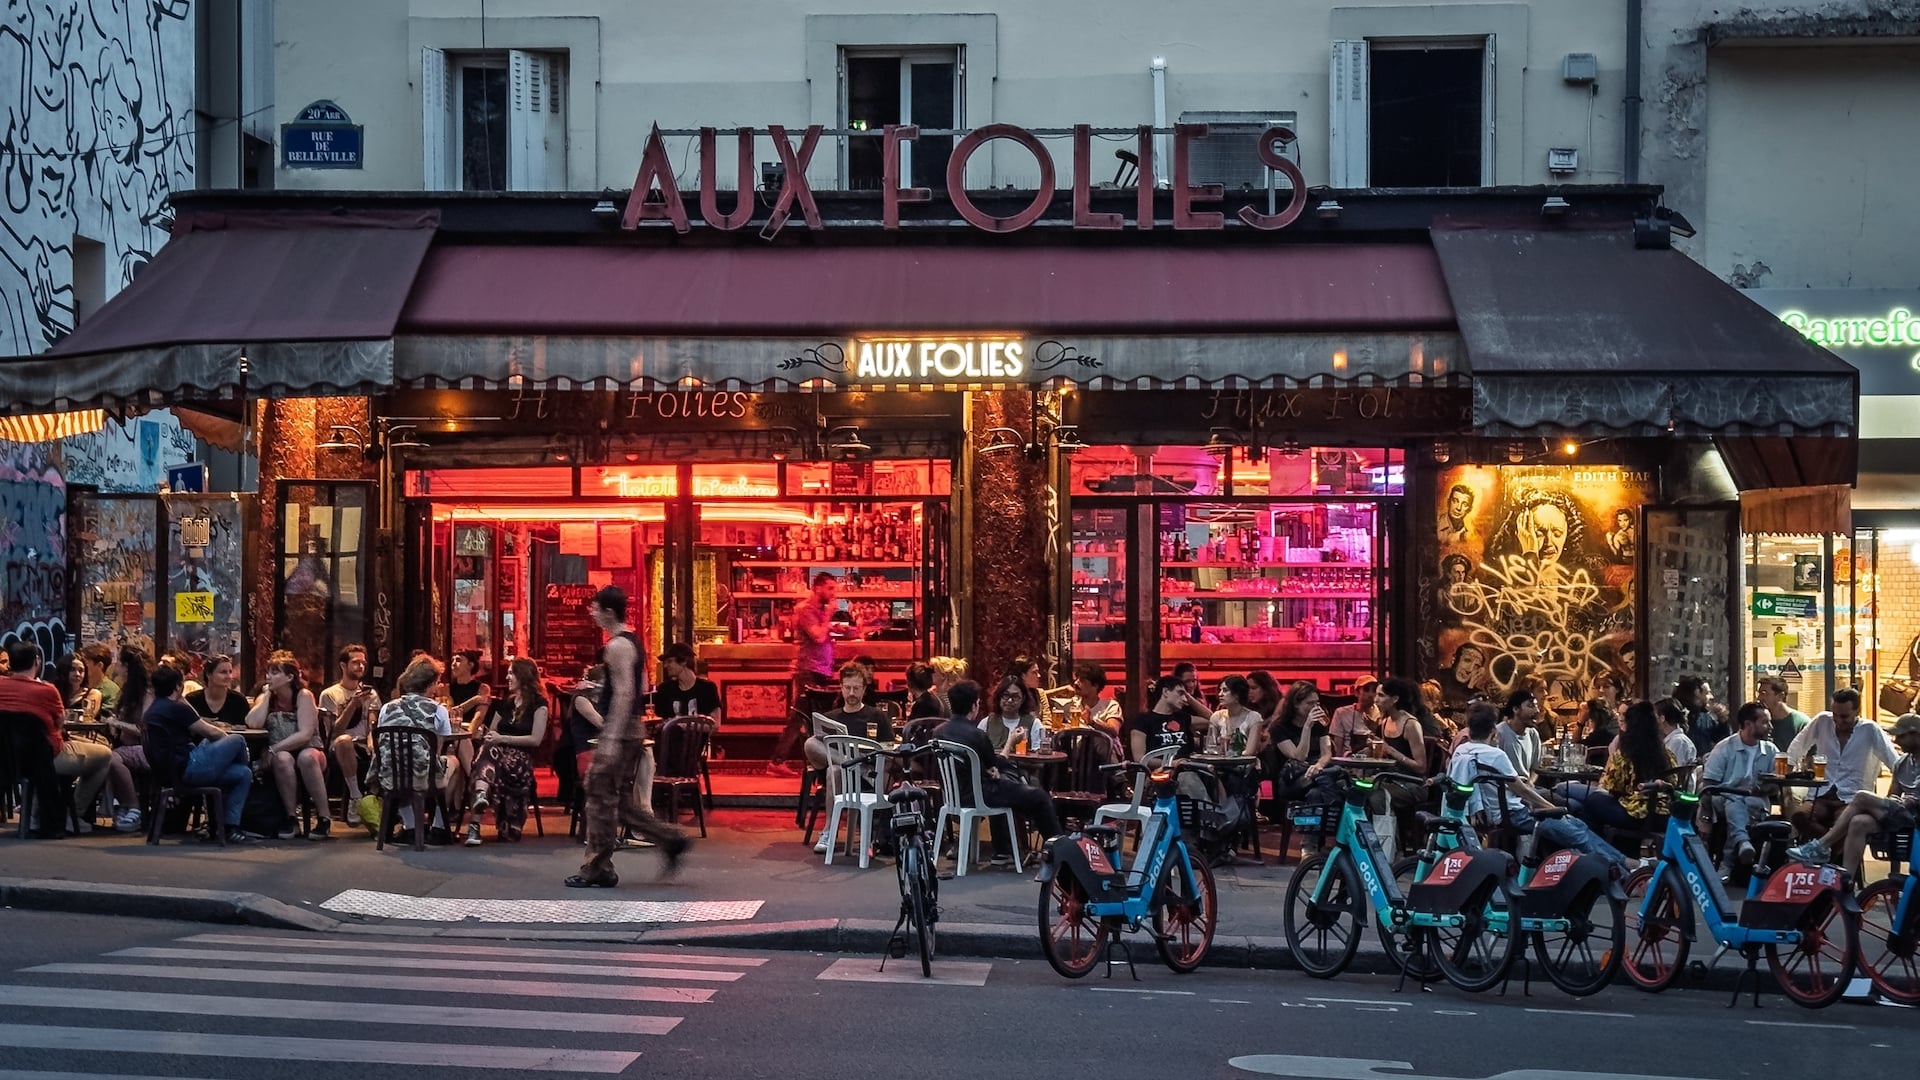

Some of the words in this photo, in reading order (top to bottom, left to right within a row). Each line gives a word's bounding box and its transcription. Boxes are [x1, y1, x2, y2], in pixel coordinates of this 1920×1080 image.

[311, 131, 333, 141] RUE
[315, 142, 330, 151] DE
[288, 152, 356, 161] BELLEVILLE
[621, 123, 824, 234] AUX
[882, 123, 1307, 234] FOLIES
[858, 342, 912, 377] AUX
[920, 342, 1023, 377] FOLIES
[1574, 472, 1617, 482] EDITH
[1150, 849, 1166, 889] dott
[1359, 861, 1378, 897] dott
[1686, 871, 1710, 912] dott
